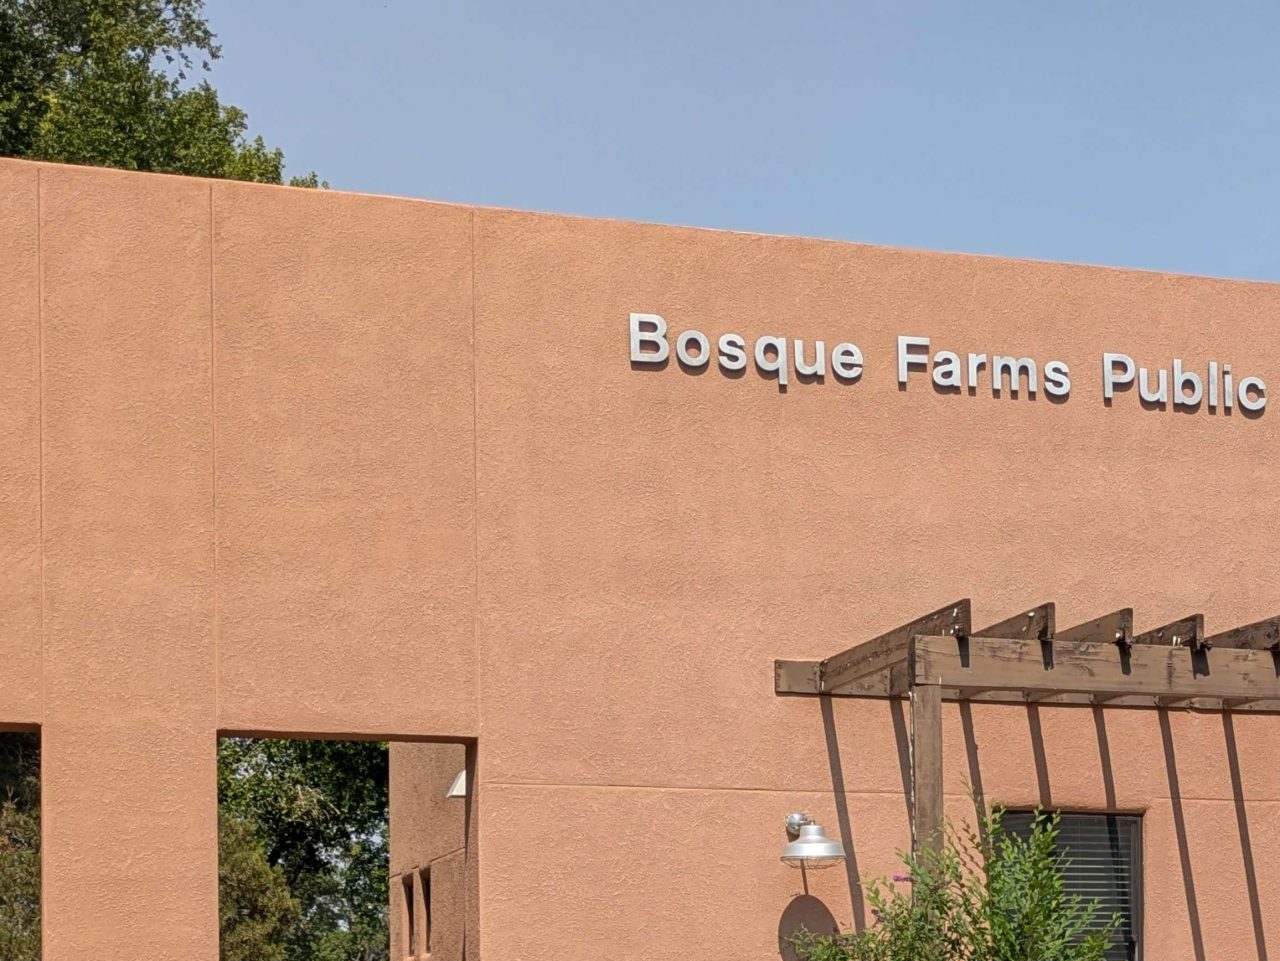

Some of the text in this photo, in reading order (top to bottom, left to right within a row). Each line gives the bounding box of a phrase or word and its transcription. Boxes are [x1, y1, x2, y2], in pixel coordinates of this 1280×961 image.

[628, 312, 864, 386] Bosque
[897, 335, 1072, 398] Farms
[1103, 353, 1268, 412] Public
